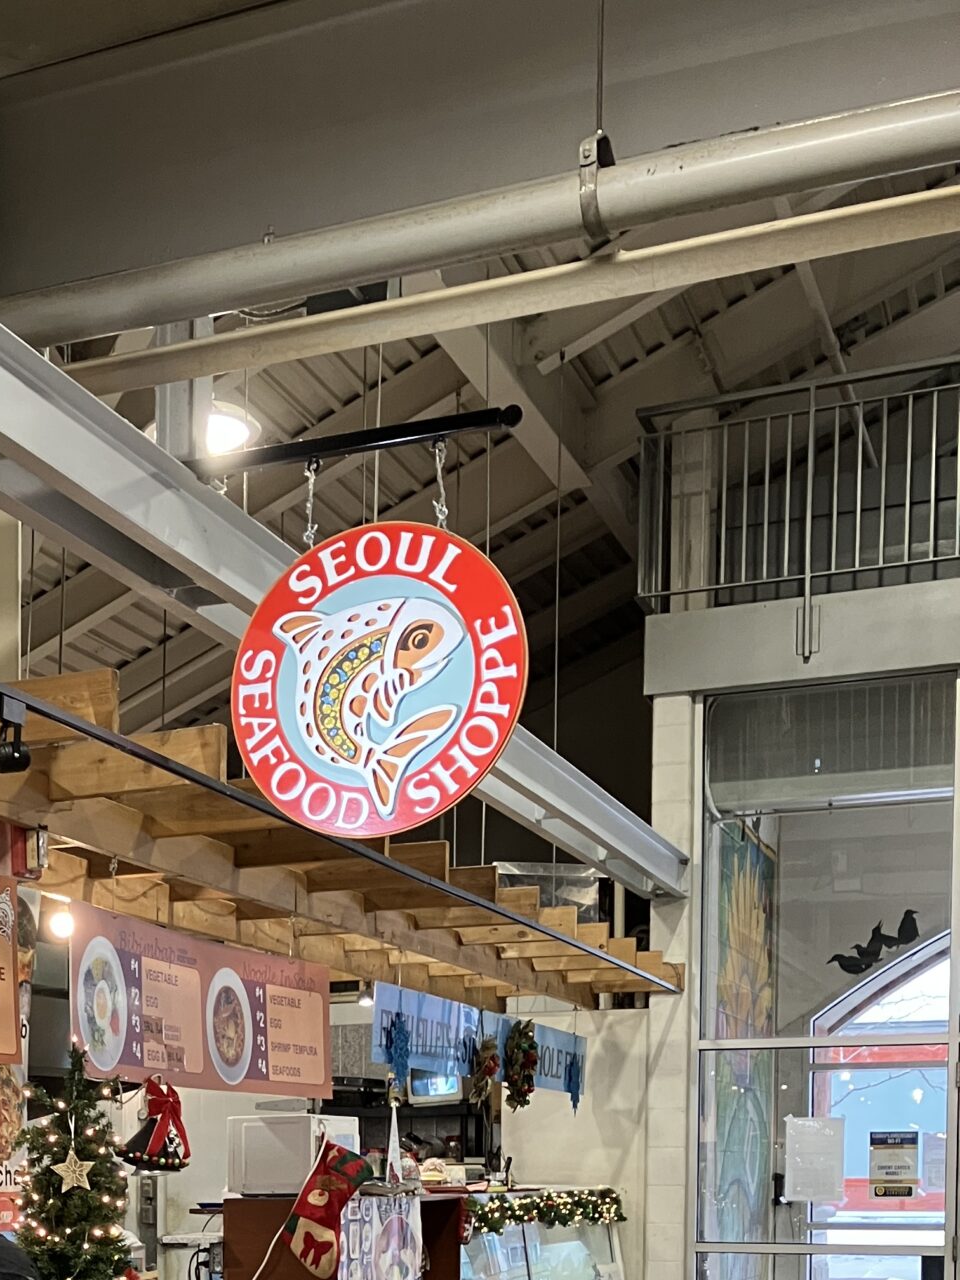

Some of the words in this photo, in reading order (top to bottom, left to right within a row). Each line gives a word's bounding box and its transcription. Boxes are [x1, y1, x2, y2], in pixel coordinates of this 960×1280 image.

[289, 531, 462, 604] SEOUL
[407, 605, 518, 814] SHOPPE
[238, 649, 369, 829] SEAFOOD
[131, 959, 139, 978] #1
[145, 969, 178, 987] VEGETABLE
[131, 987, 140, 1005] #2
[145, 995, 159, 1009] EGG
[256, 986, 263, 1003] #1
[270, 995, 302, 1009] VEGETABLE
[132, 1014, 140, 1032] #3
[256, 1011, 265, 1027] #2
[270, 1018, 282, 1029] EGG
[132, 1041, 141, 1060] #4
[147, 1049, 160, 1062] EGG
[257, 1034, 265, 1051] #3
[271, 1041, 291, 1053] SHRIMP
[293, 1043, 318, 1056] TEMPURA
[258, 1058, 266, 1074] #4
